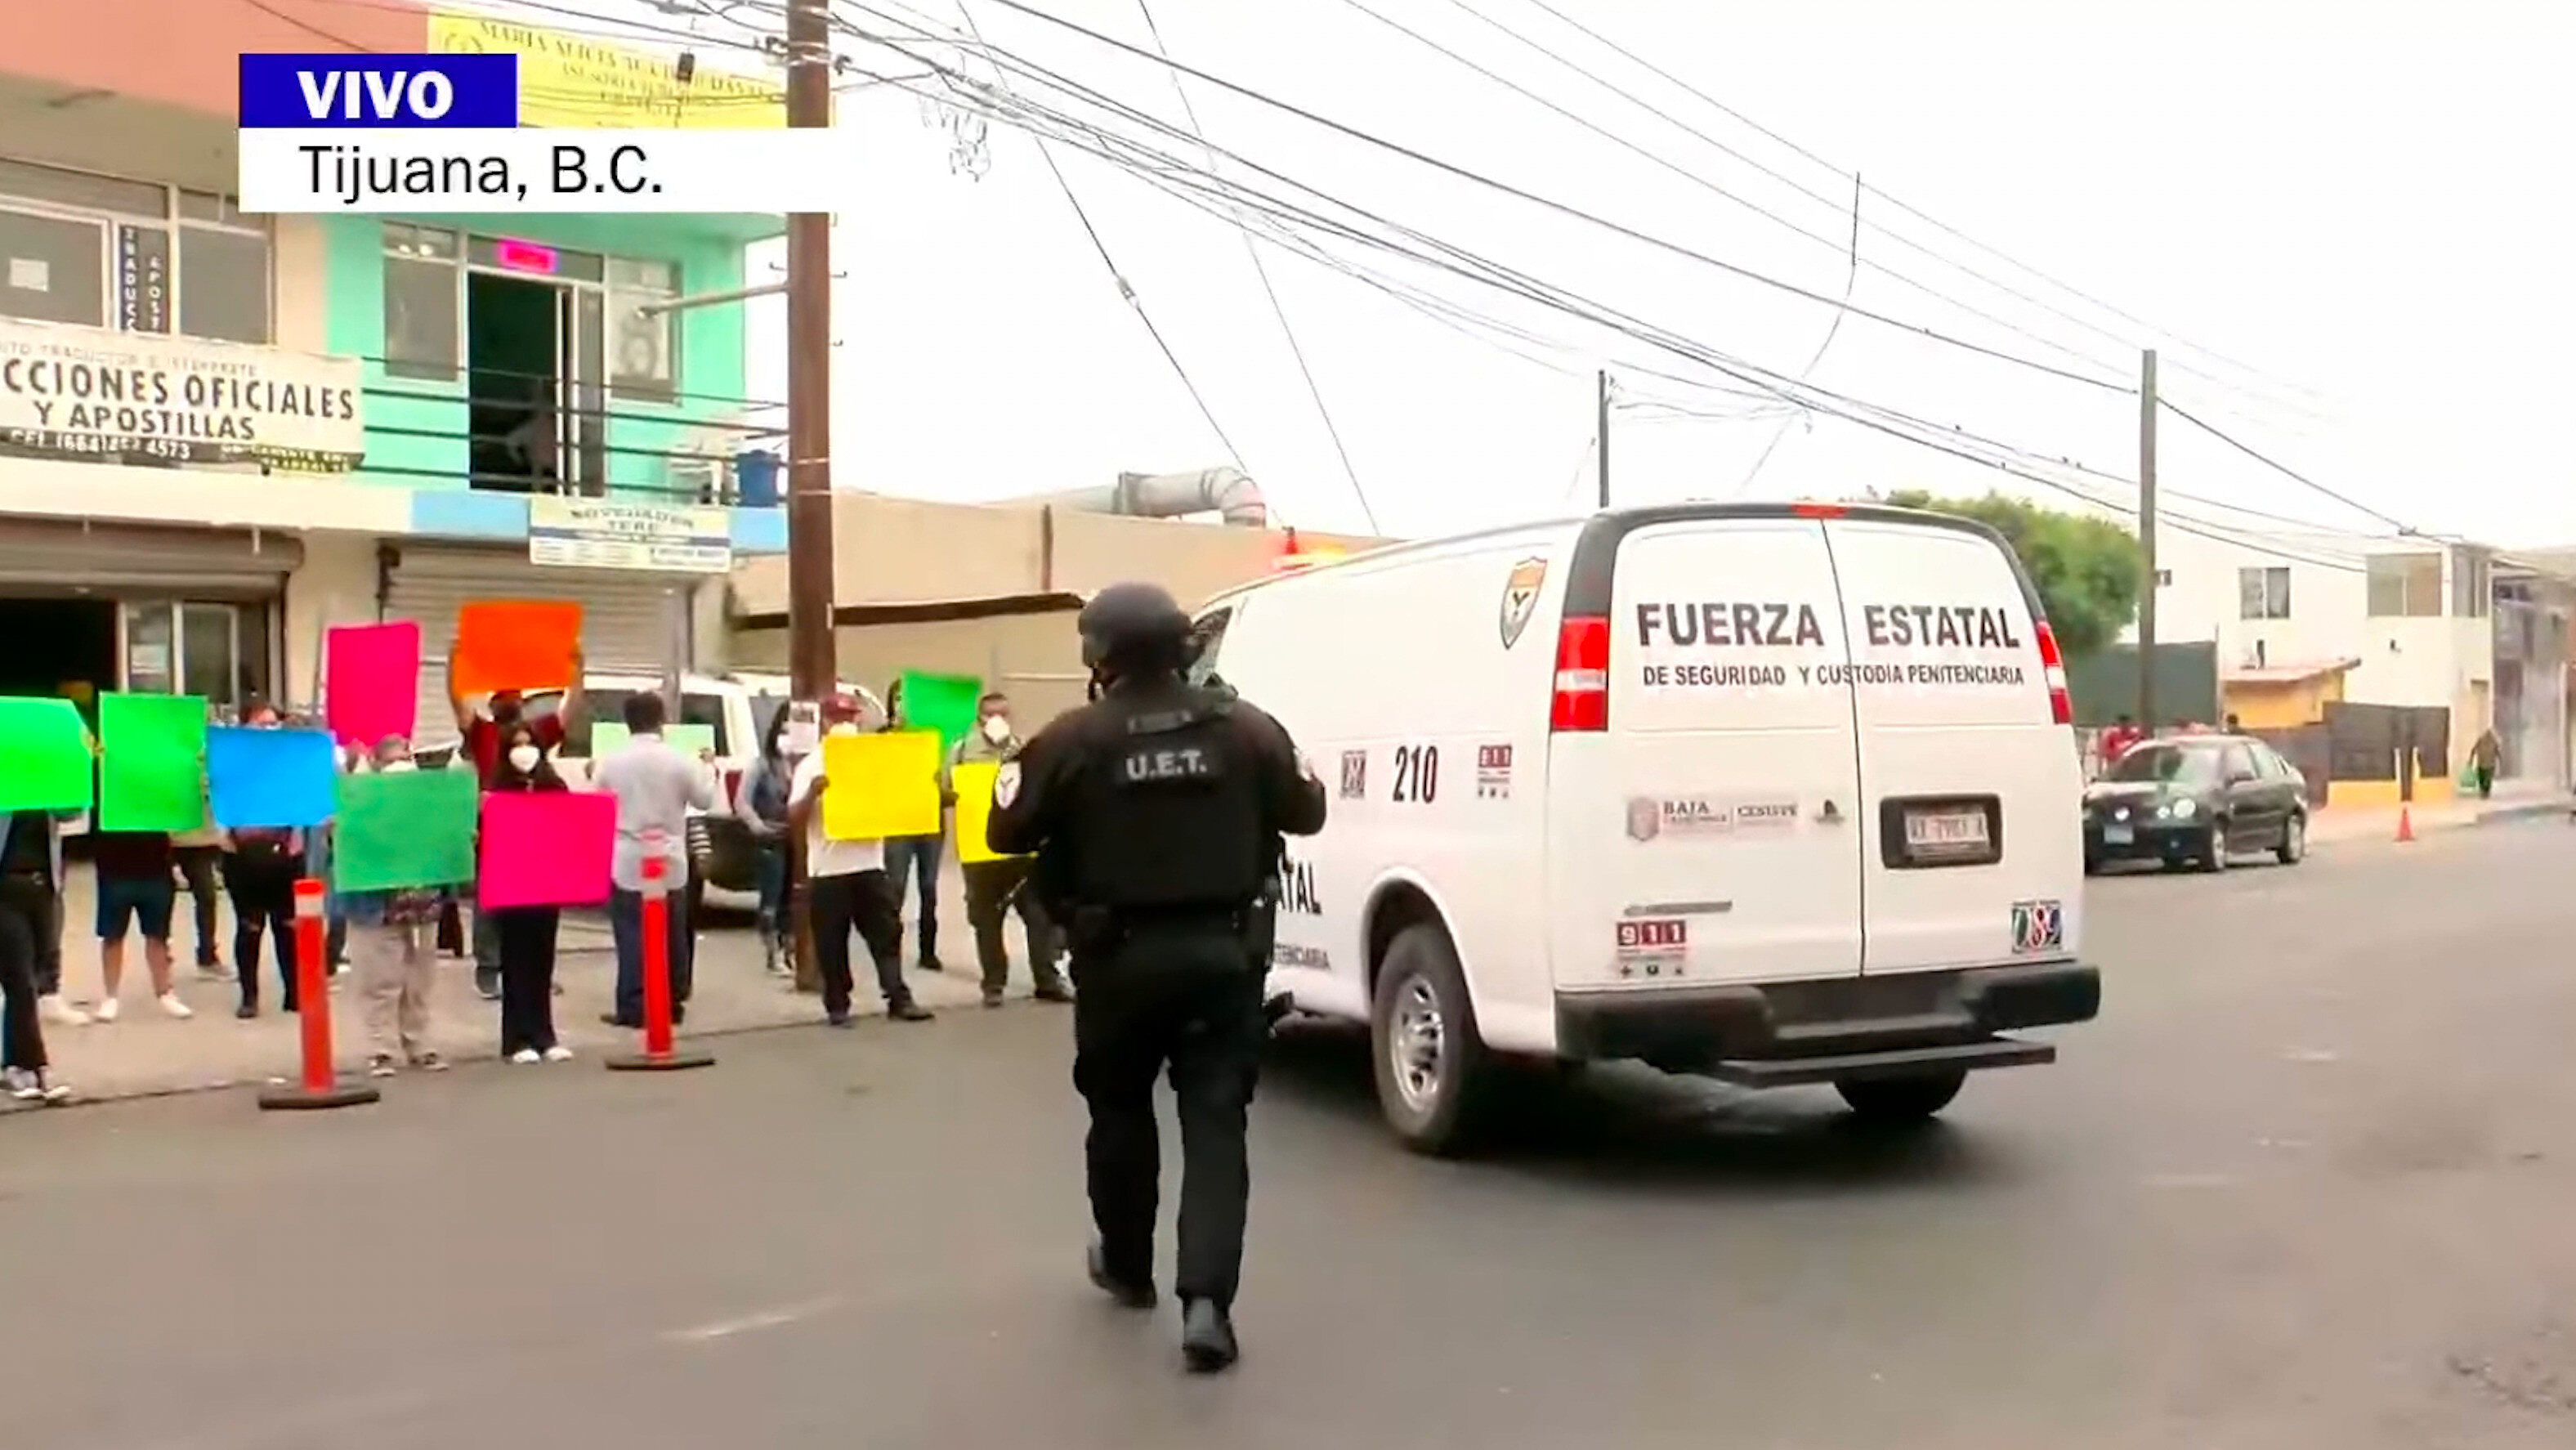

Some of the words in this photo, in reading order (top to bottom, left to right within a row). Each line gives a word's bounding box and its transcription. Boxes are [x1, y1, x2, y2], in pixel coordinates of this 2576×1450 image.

[3, 358, 168, 405] CCIONES
[185, 374, 354, 420] OFICIALES
[33, 399, 54, 426] Y
[69, 403, 255, 441] APOSTILLAS
[1636, 603, 1825, 647] FUERZA
[1863, 605, 2020, 648] ESTATAL
[1643, 665, 1669, 686] DE
[1675, 665, 1787, 686] SEGURIDAD
[1799, 666, 1811, 686] Y
[1817, 664, 1904, 685] CUSTODIA
[1907, 665, 2025, 686] PENITENCIARIA
[1125, 748, 1208, 781] U.E.T.
[1392, 745, 1438, 804] 210
[1663, 801, 1710, 815] BAJA
[1620, 922, 1684, 946] 911
